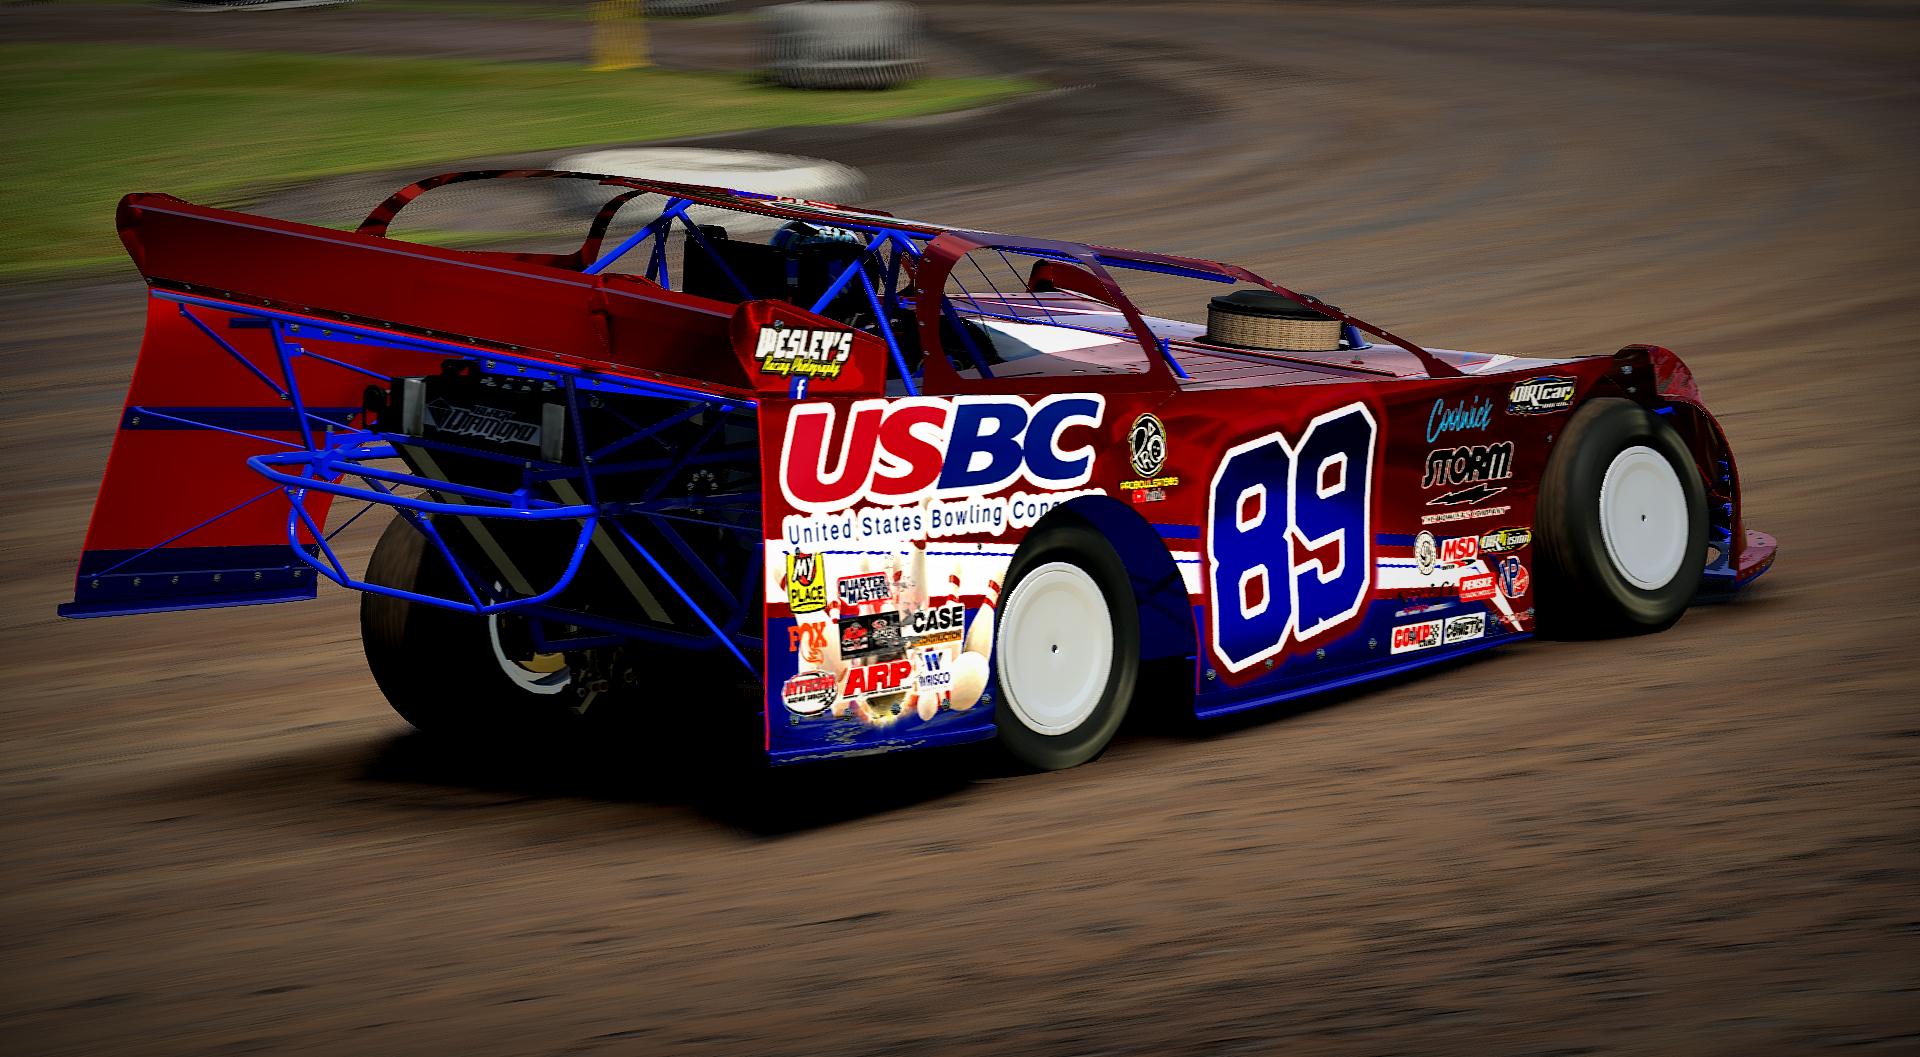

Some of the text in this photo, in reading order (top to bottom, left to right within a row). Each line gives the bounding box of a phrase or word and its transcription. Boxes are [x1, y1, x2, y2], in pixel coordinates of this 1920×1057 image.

[755, 327, 853, 362] WESLEY'S
[1512, 383, 1574, 406] DIRTcar
[446, 408, 538, 442] DIAMOND
[785, 397, 1102, 505] USBC
[1421, 441, 1515, 489] STORM
[788, 518, 852, 546] United
[862, 512, 922, 537] States
[931, 504, 1003, 529] Bowling
[1206, 400, 1378, 674] 89
[1443, 537, 1476, 562] MSD
[792, 555, 816, 582] MY
[1499, 556, 1520, 598] VP
[791, 585, 824, 602] PLACE
[839, 575, 886, 598] QUARTER
[847, 586, 890, 605] MASTER
[912, 605, 963, 634] CASE
[787, 621, 827, 652] FOX
[1394, 624, 1432, 649] COMP
[843, 661, 912, 697] ARP
